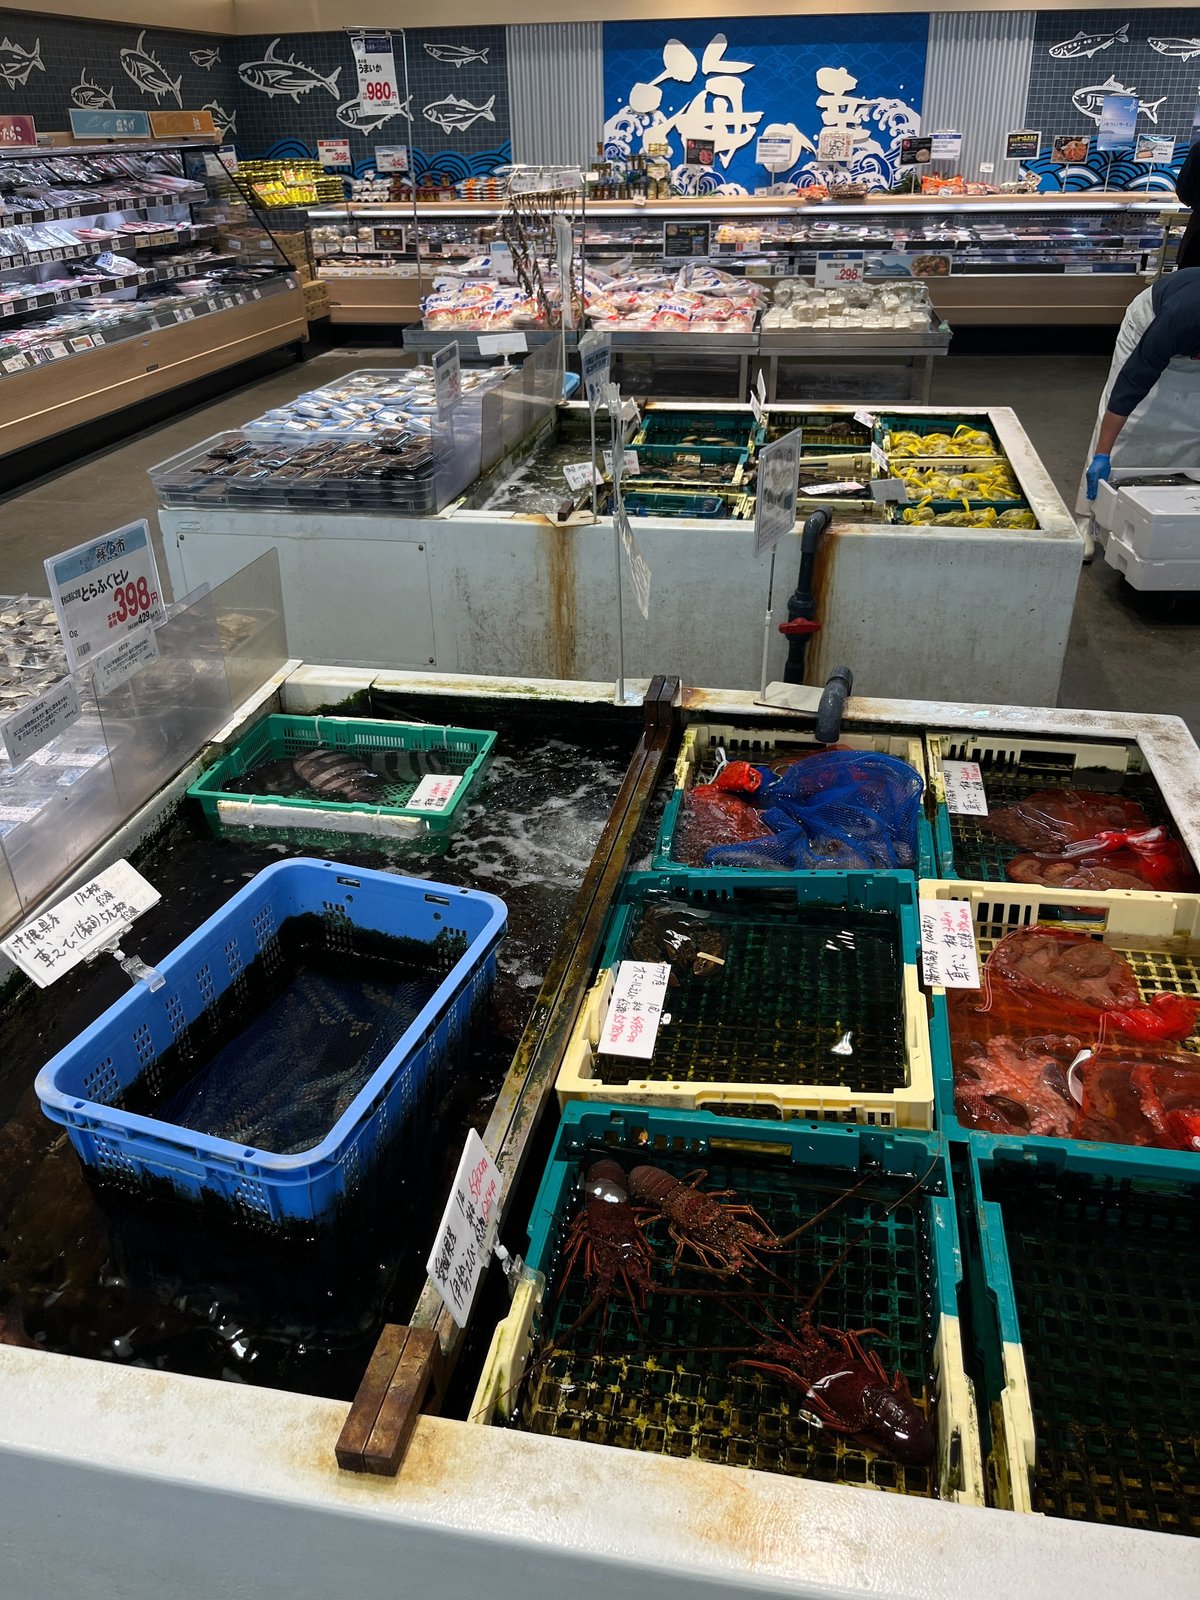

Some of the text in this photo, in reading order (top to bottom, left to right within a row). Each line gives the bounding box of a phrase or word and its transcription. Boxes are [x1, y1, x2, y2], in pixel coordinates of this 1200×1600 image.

[359, 64, 382, 73] うまいか
[81, 569, 129, 602] とらふぐヒレ
[945, 953, 971, 981] 真だこ
